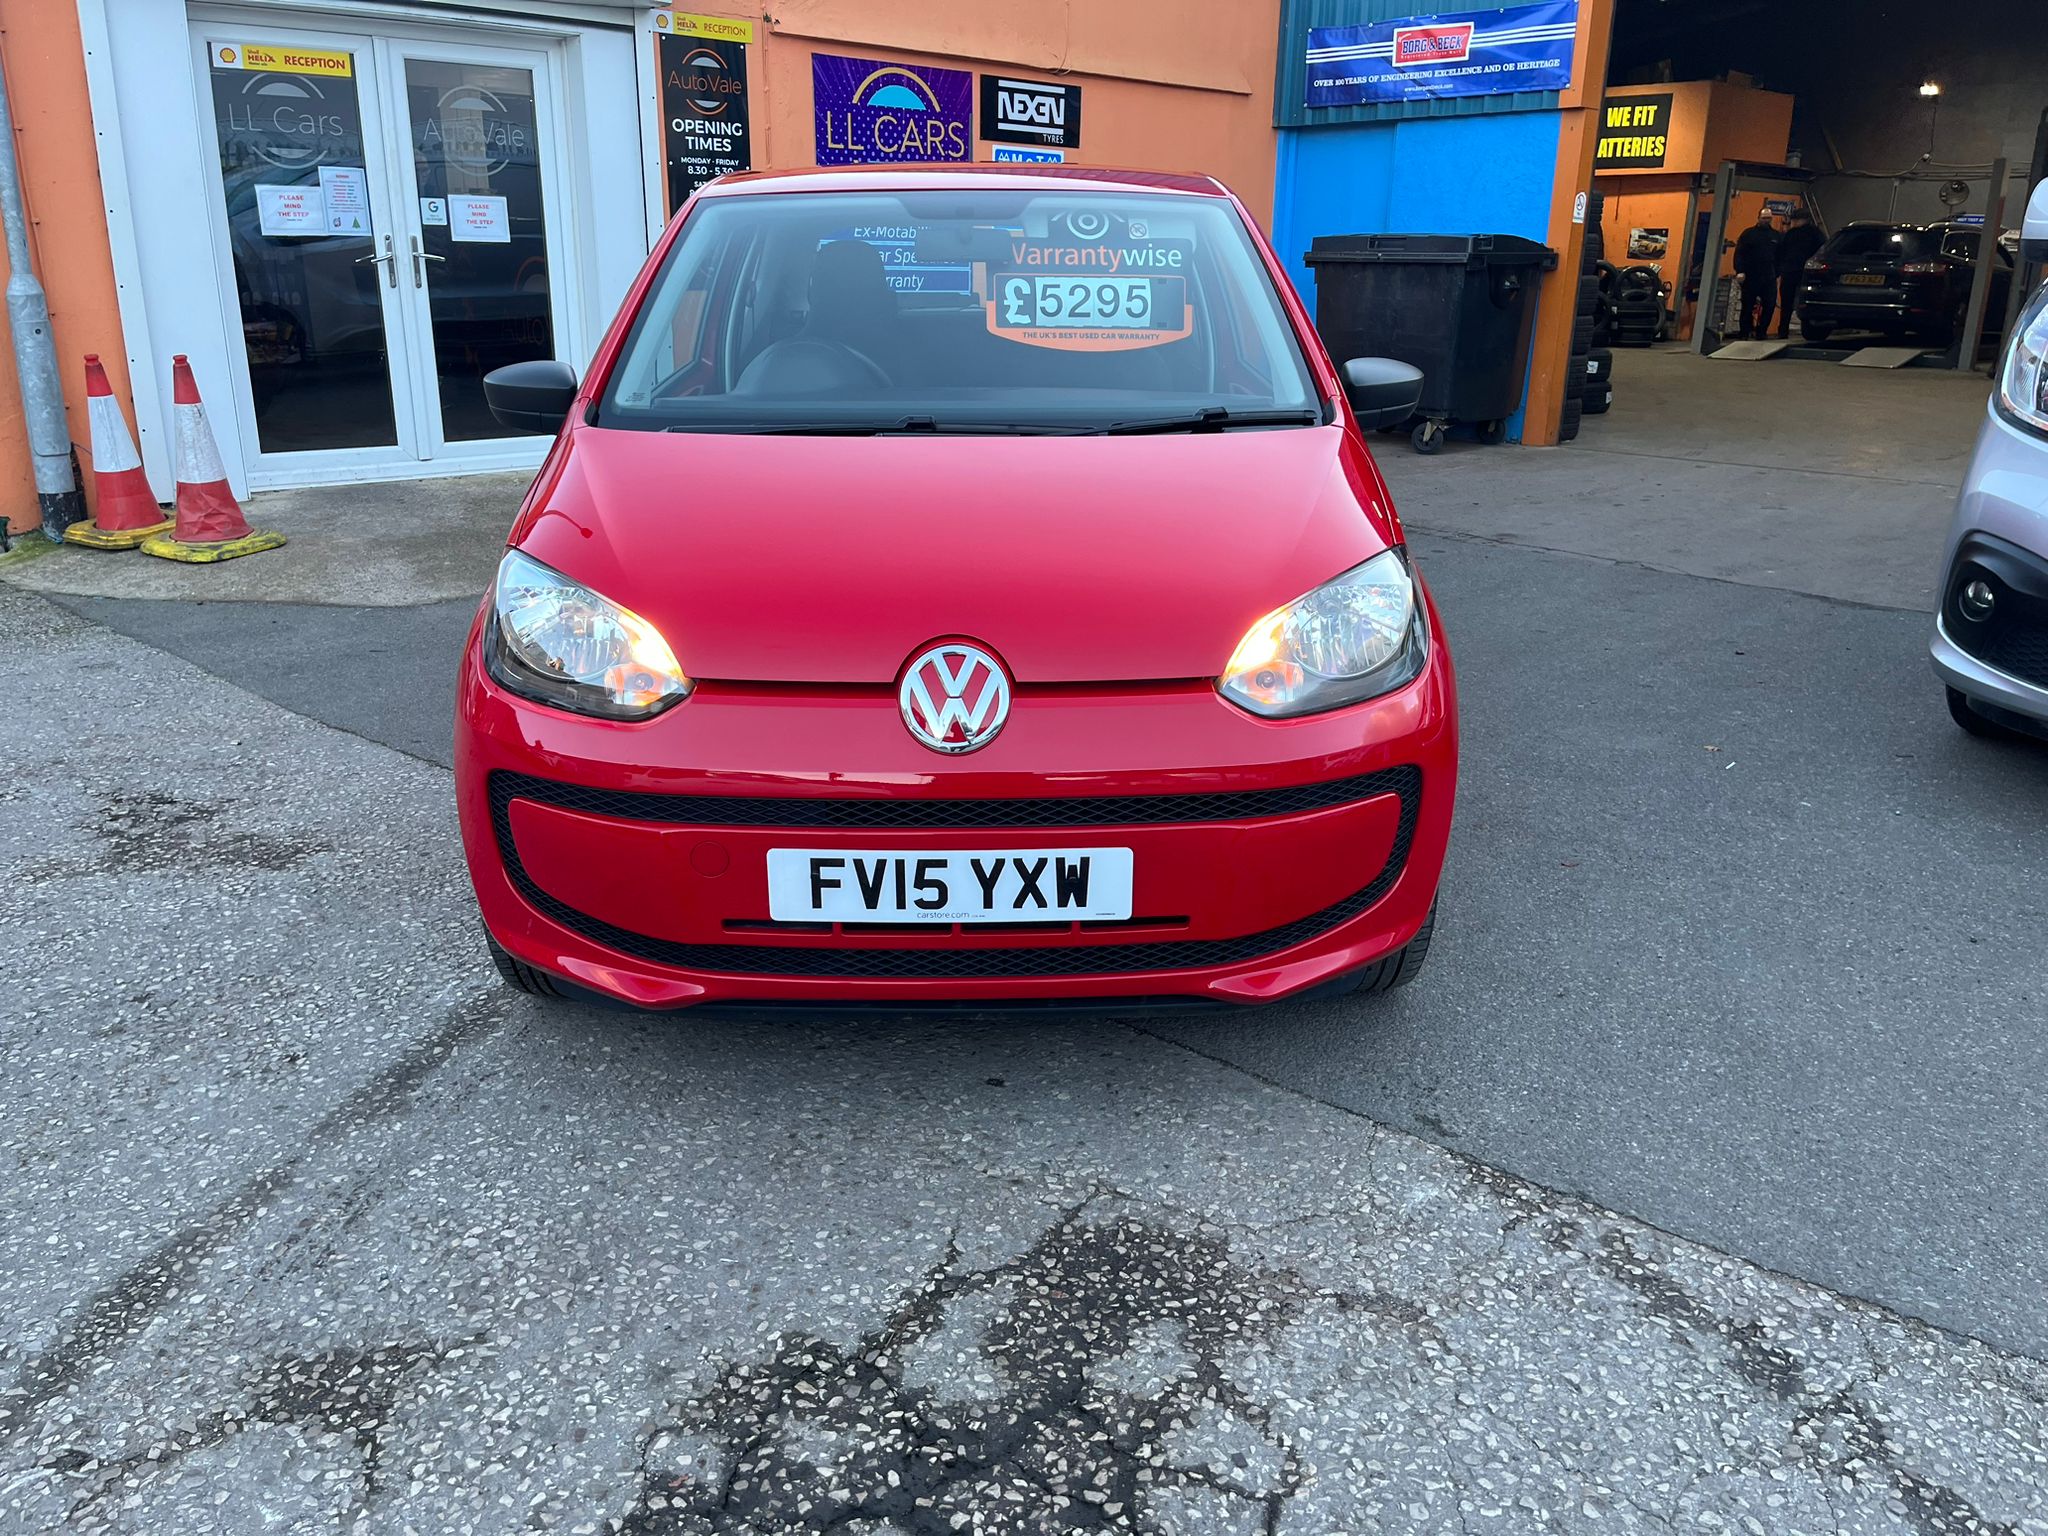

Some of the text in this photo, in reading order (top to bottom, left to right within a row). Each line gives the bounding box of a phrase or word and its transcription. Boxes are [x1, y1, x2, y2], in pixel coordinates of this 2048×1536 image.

[676, 20, 698, 29] HELIX
[703, 22, 747, 37] RECEPTION
[1402, 35, 1463, 54] BORG & BECK
[247, 53, 276, 63] HELIX
[284, 54, 346, 70] RECEPTION
[668, 70, 742, 95] AutoVale
[1313, 59, 1561, 88] OVER 100 YEARS OF ENGINEERING EXCELLENCE AND OE HERITAGE
[998, 91, 1065, 126] NEXEN
[1606, 105, 1658, 128] WE FIT
[227, 103, 344, 136] LL Cars
[672, 118, 743, 137] OPENING
[827, 110, 965, 158] LL CARS
[1042, 134, 1064, 144] TYRES
[685, 135, 732, 152] TIMES
[1596, 135, 1666, 158] ATTERIES
[680, 156, 711, 165] MONDAY
[715, 158, 739, 167] FRIDAY
[687, 165, 708, 175] 8.30
[714, 166, 734, 176] 530
[854, 225, 928, 239] Ex-Motab
[885, 273, 925, 291] rranty
[1003, 277, 1150, 325] £5295
[1023, 331, 1160, 341] THE UK'S BEST USED CAR WARRANTY
[810, 856, 1090, 909] FV15 YXW
